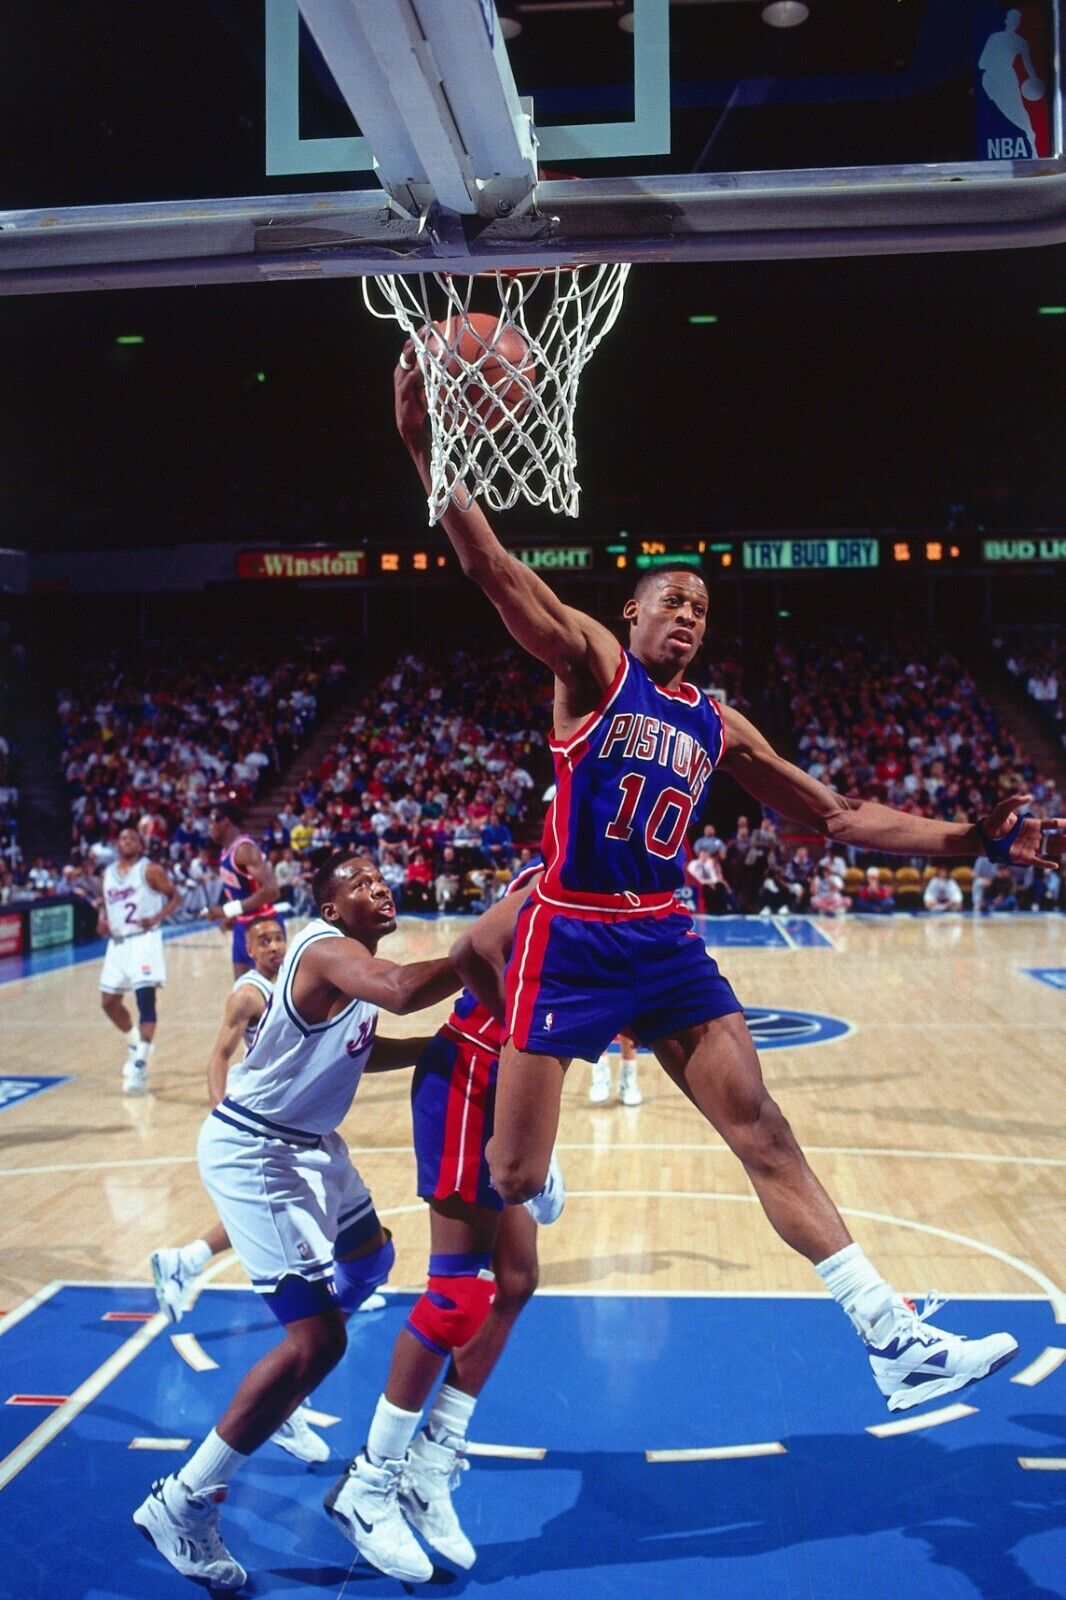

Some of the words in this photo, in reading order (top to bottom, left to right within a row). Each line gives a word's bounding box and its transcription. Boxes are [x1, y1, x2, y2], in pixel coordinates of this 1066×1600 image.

[987, 137, 1028, 159] NBA
[520, 548, 590, 568] LIGHT
[748, 542, 781, 567] TRY
[791, 541, 828, 566] BUD
[837, 540, 873, 565] DRY
[985, 540, 1036, 560] BUD
[263, 551, 363, 576] Winston
[605, 772, 694, 860] 10
[124, 902, 137, 924] 2
